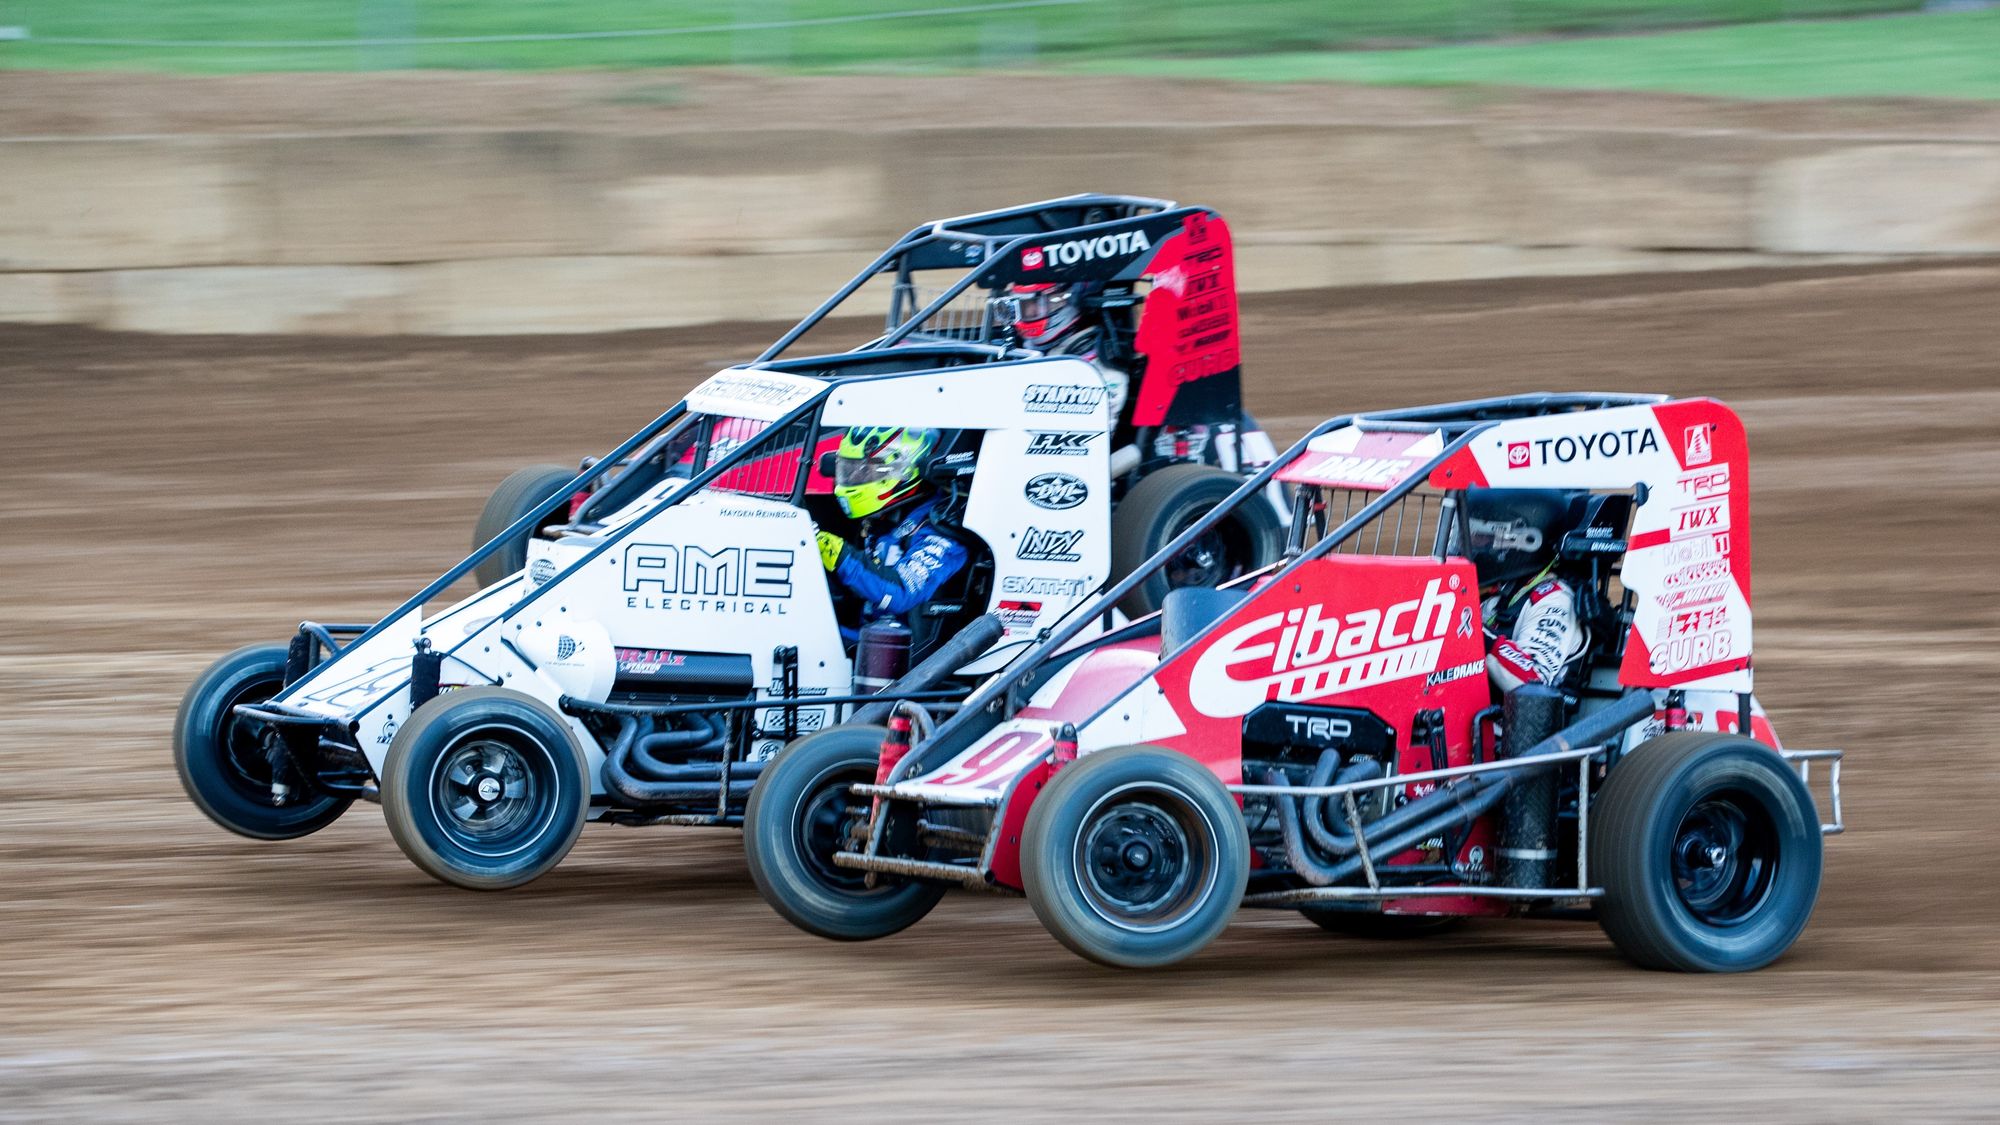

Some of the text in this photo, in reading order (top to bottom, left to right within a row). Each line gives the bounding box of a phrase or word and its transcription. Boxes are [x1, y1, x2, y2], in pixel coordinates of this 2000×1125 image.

[1042, 230, 1151, 267] TOYOTA
[1023, 384, 1106, 406] STANTON
[1535, 428, 1660, 465] TOYOTA
[1304, 456, 1412, 484] DRAKE
[1676, 472, 1729, 495] TRD
[720, 509, 798, 519] HAYDEN REINBOLD
[1678, 506, 1721, 531] IWX
[1018, 527, 1085, 555] INDY
[623, 543, 794, 598] AME
[627, 597, 787, 614] ELECTRICAL
[1189, 578, 1456, 718] Eibach
[1649, 629, 1732, 677] CURB
[1286, 715, 1351, 741] TRD
